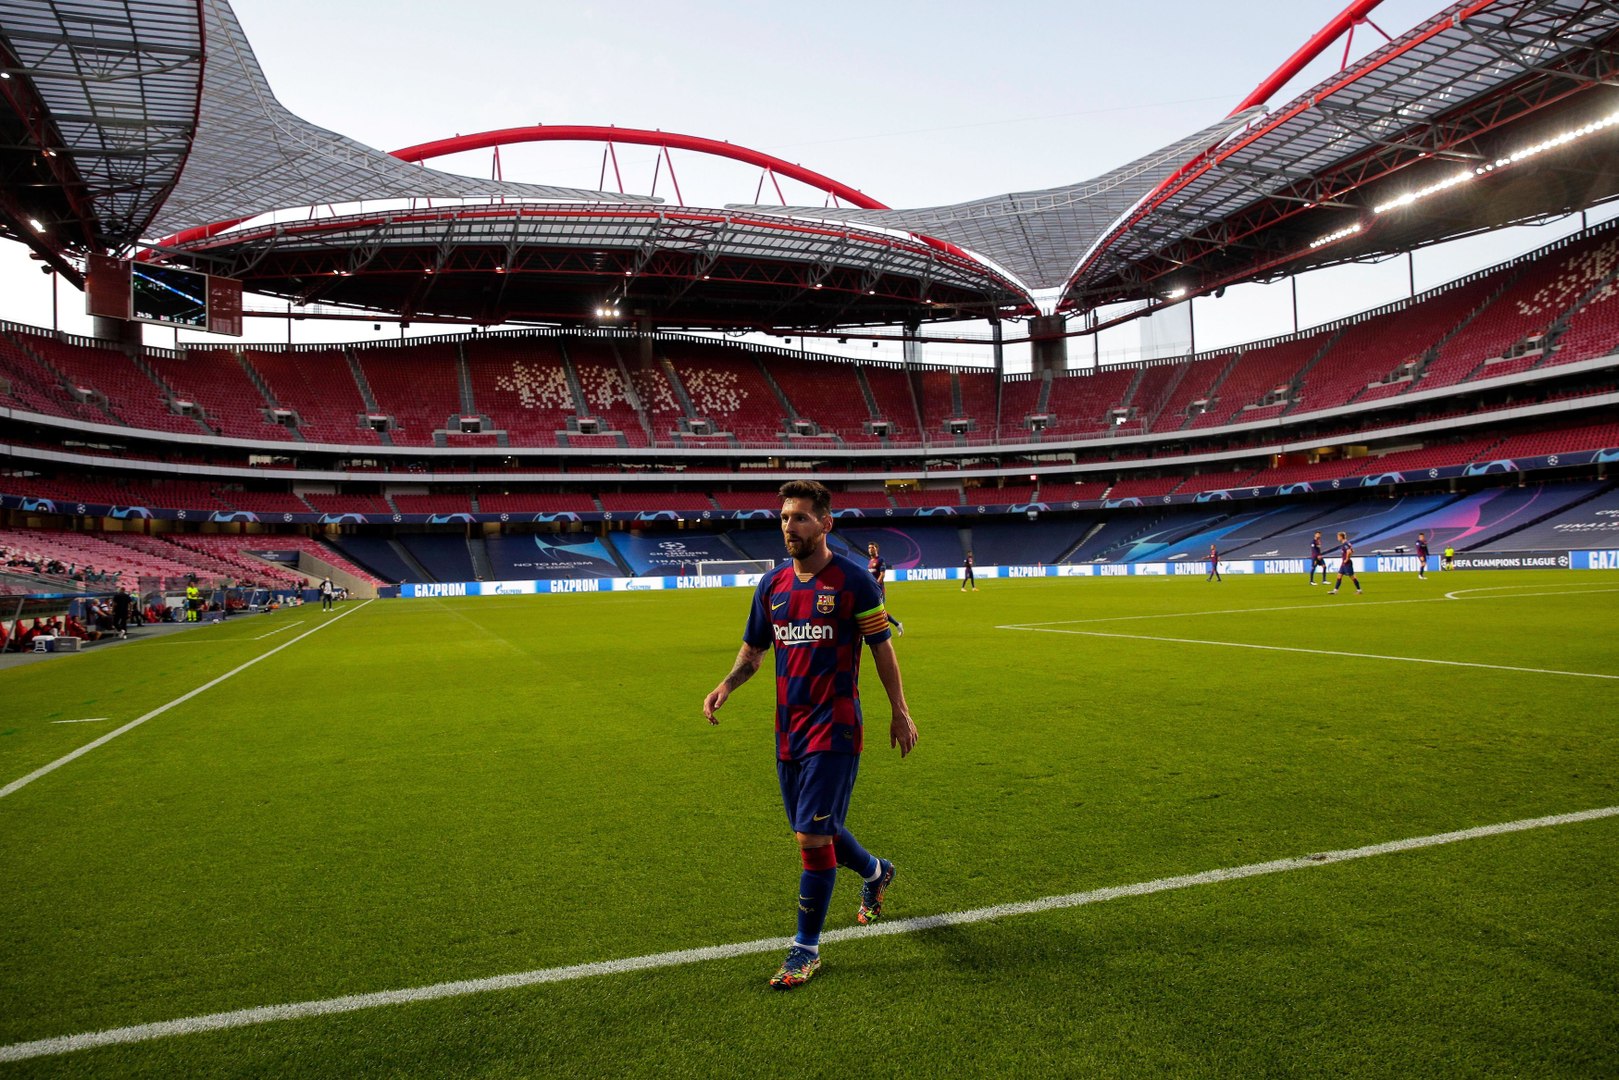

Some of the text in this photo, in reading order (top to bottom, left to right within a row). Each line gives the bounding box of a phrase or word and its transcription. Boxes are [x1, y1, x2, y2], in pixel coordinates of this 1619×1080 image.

[1474, 558, 1520, 567] CHAMPIONS
[1522, 557, 1556, 566] LEAGUE
[1589, 551, 1619, 569] GAZ
[1008, 566, 1047, 577] GAZPROM
[1101, 564, 1128, 575] GAZPROM
[1175, 562, 1206, 574] GAZPROM
[1264, 560, 1304, 573] GAZPROM
[906, 568, 947, 580] GAZPROM
[550, 578, 599, 592] GAZPROM
[677, 576, 722, 588] GAZPROM
[414, 582, 467, 597] GAZPROM
[772, 622, 833, 640] Rakuten
